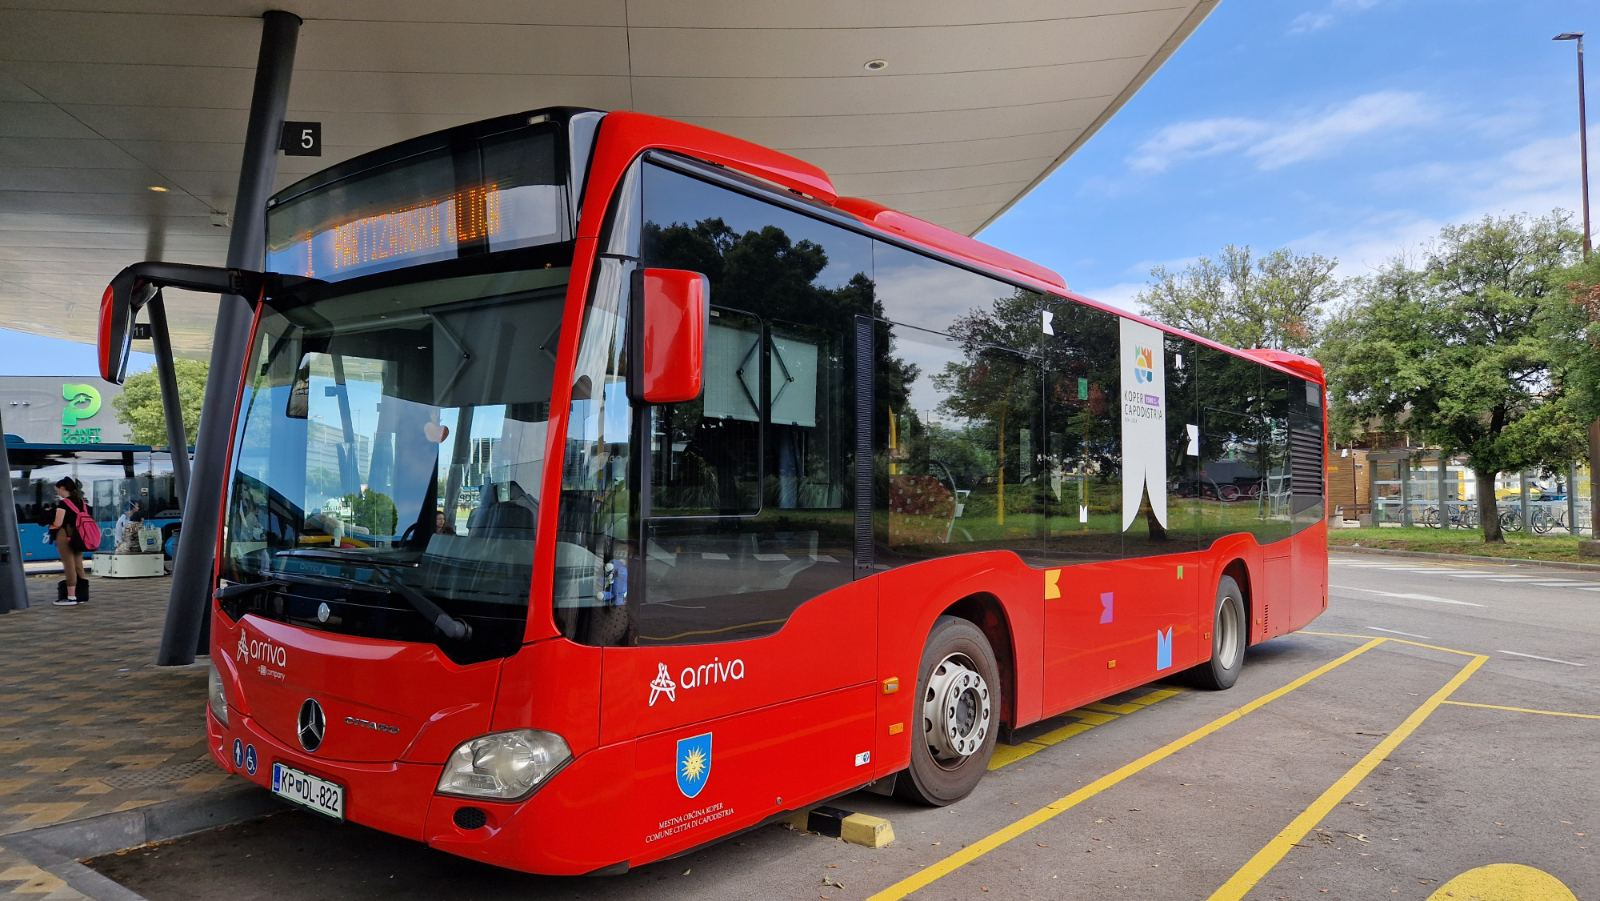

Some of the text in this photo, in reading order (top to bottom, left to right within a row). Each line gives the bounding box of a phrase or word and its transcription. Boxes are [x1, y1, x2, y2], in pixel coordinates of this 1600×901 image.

[301, 129, 314, 149] 5
[135, 326, 144, 337] 11
[1124, 390, 1144, 404] KOPER
[1124, 403, 1163, 419] CAPODISTRIA
[62, 427, 102, 437] PLANET
[62, 436, 102, 444] KOPER
[250, 638, 286, 668] arriva
[680, 656, 745, 689] arriva
[281, 770, 339, 812] KP DL-822
[645, 828, 673, 843] COMUNE
[698, 808, 734, 825] CAPODISTRIA
[658, 816, 683, 830] MESTNA
[706, 802, 724, 813] KOPER
